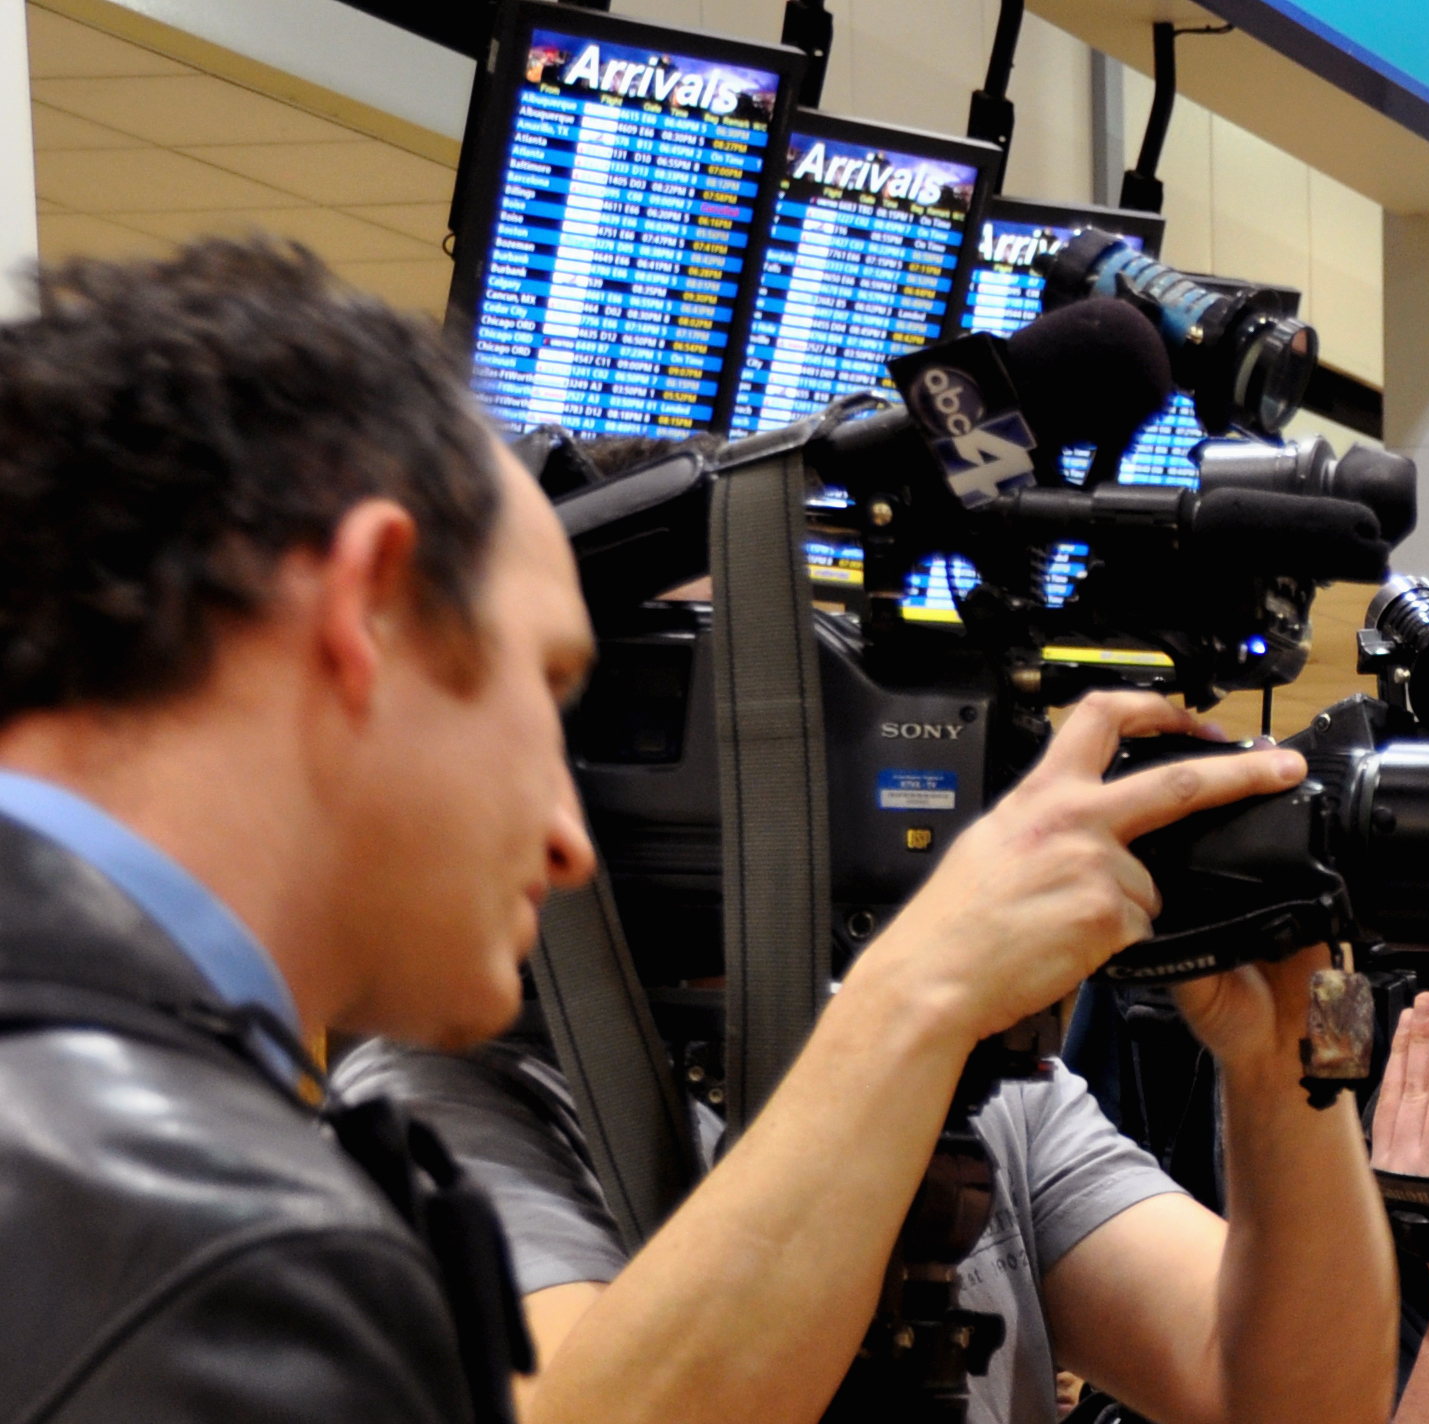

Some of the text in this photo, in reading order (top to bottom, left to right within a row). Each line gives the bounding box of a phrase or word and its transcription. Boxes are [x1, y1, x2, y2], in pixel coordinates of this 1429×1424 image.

[564, 44, 740, 113] Arrivals
[601, 94, 623, 107] Flight
[671, 106, 688, 118] Time
[704, 113, 719, 125] Bag
[512, 146, 544, 160] Atlanta
[515, 133, 547, 147] Atlanta
[510, 159, 551, 174] Baltimore
[792, 141, 942, 206] Arrivals
[823, 187, 843, 199] Flight
[883, 199, 898, 210] Time
[979, 222, 1061, 265] Arriv
[924, 369, 972, 436] abc
[949, 428, 1035, 502] 4
[881, 722, 963, 739] SONY
[1105, 956, 1216, 979] Canon
